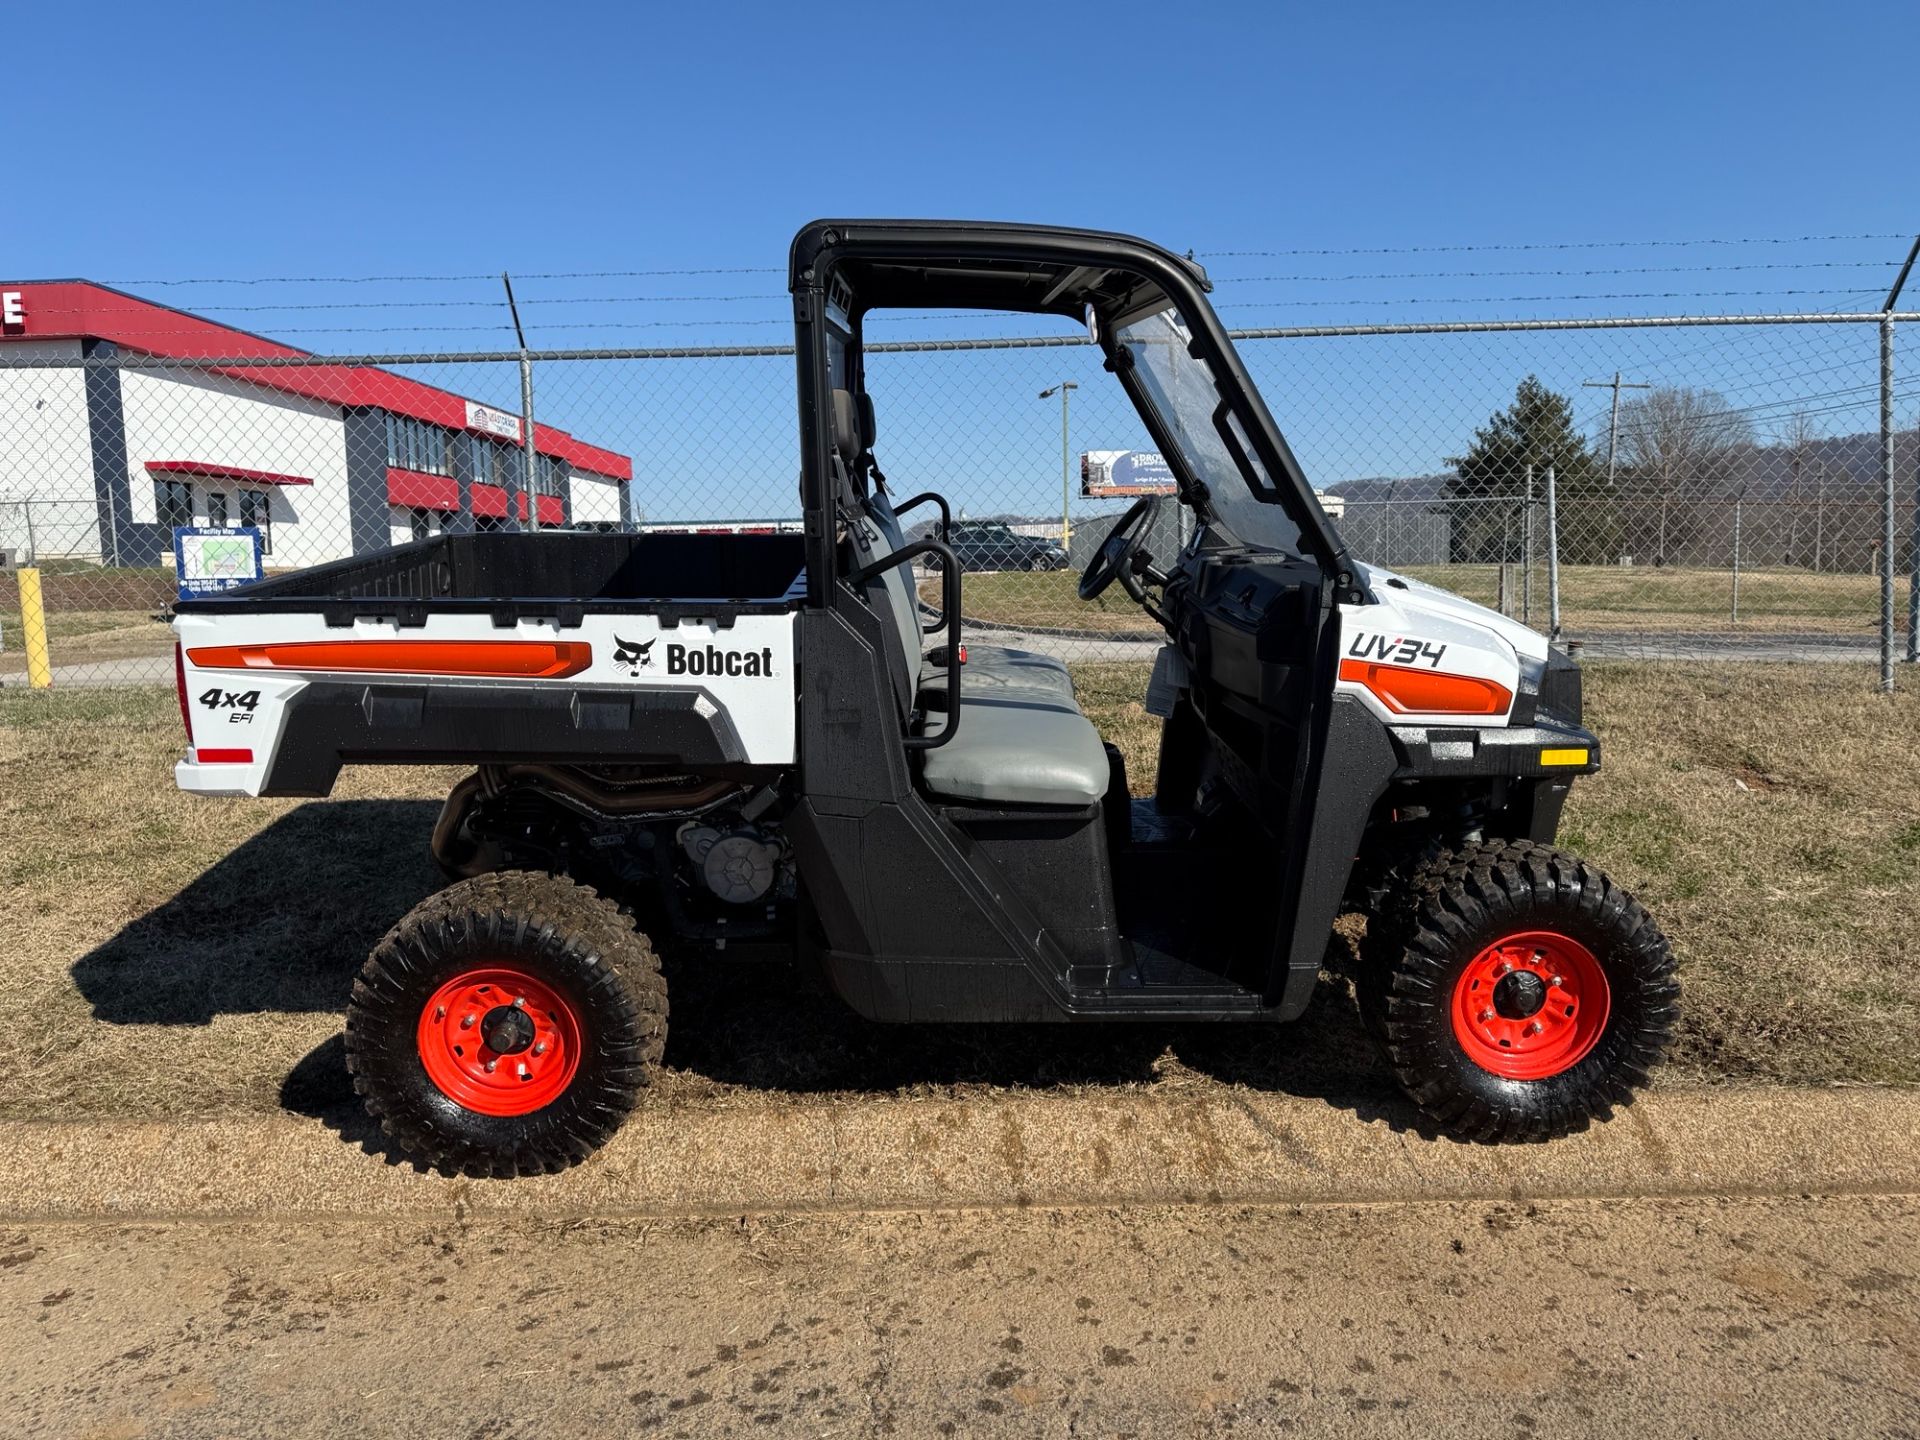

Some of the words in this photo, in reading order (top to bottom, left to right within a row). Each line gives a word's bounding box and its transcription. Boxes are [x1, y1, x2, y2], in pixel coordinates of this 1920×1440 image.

[666, 643, 773, 677] Bobcat
[1349, 632, 1447, 668] UV34
[198, 687, 261, 712] 4x4
[229, 712, 254, 724] EFI
